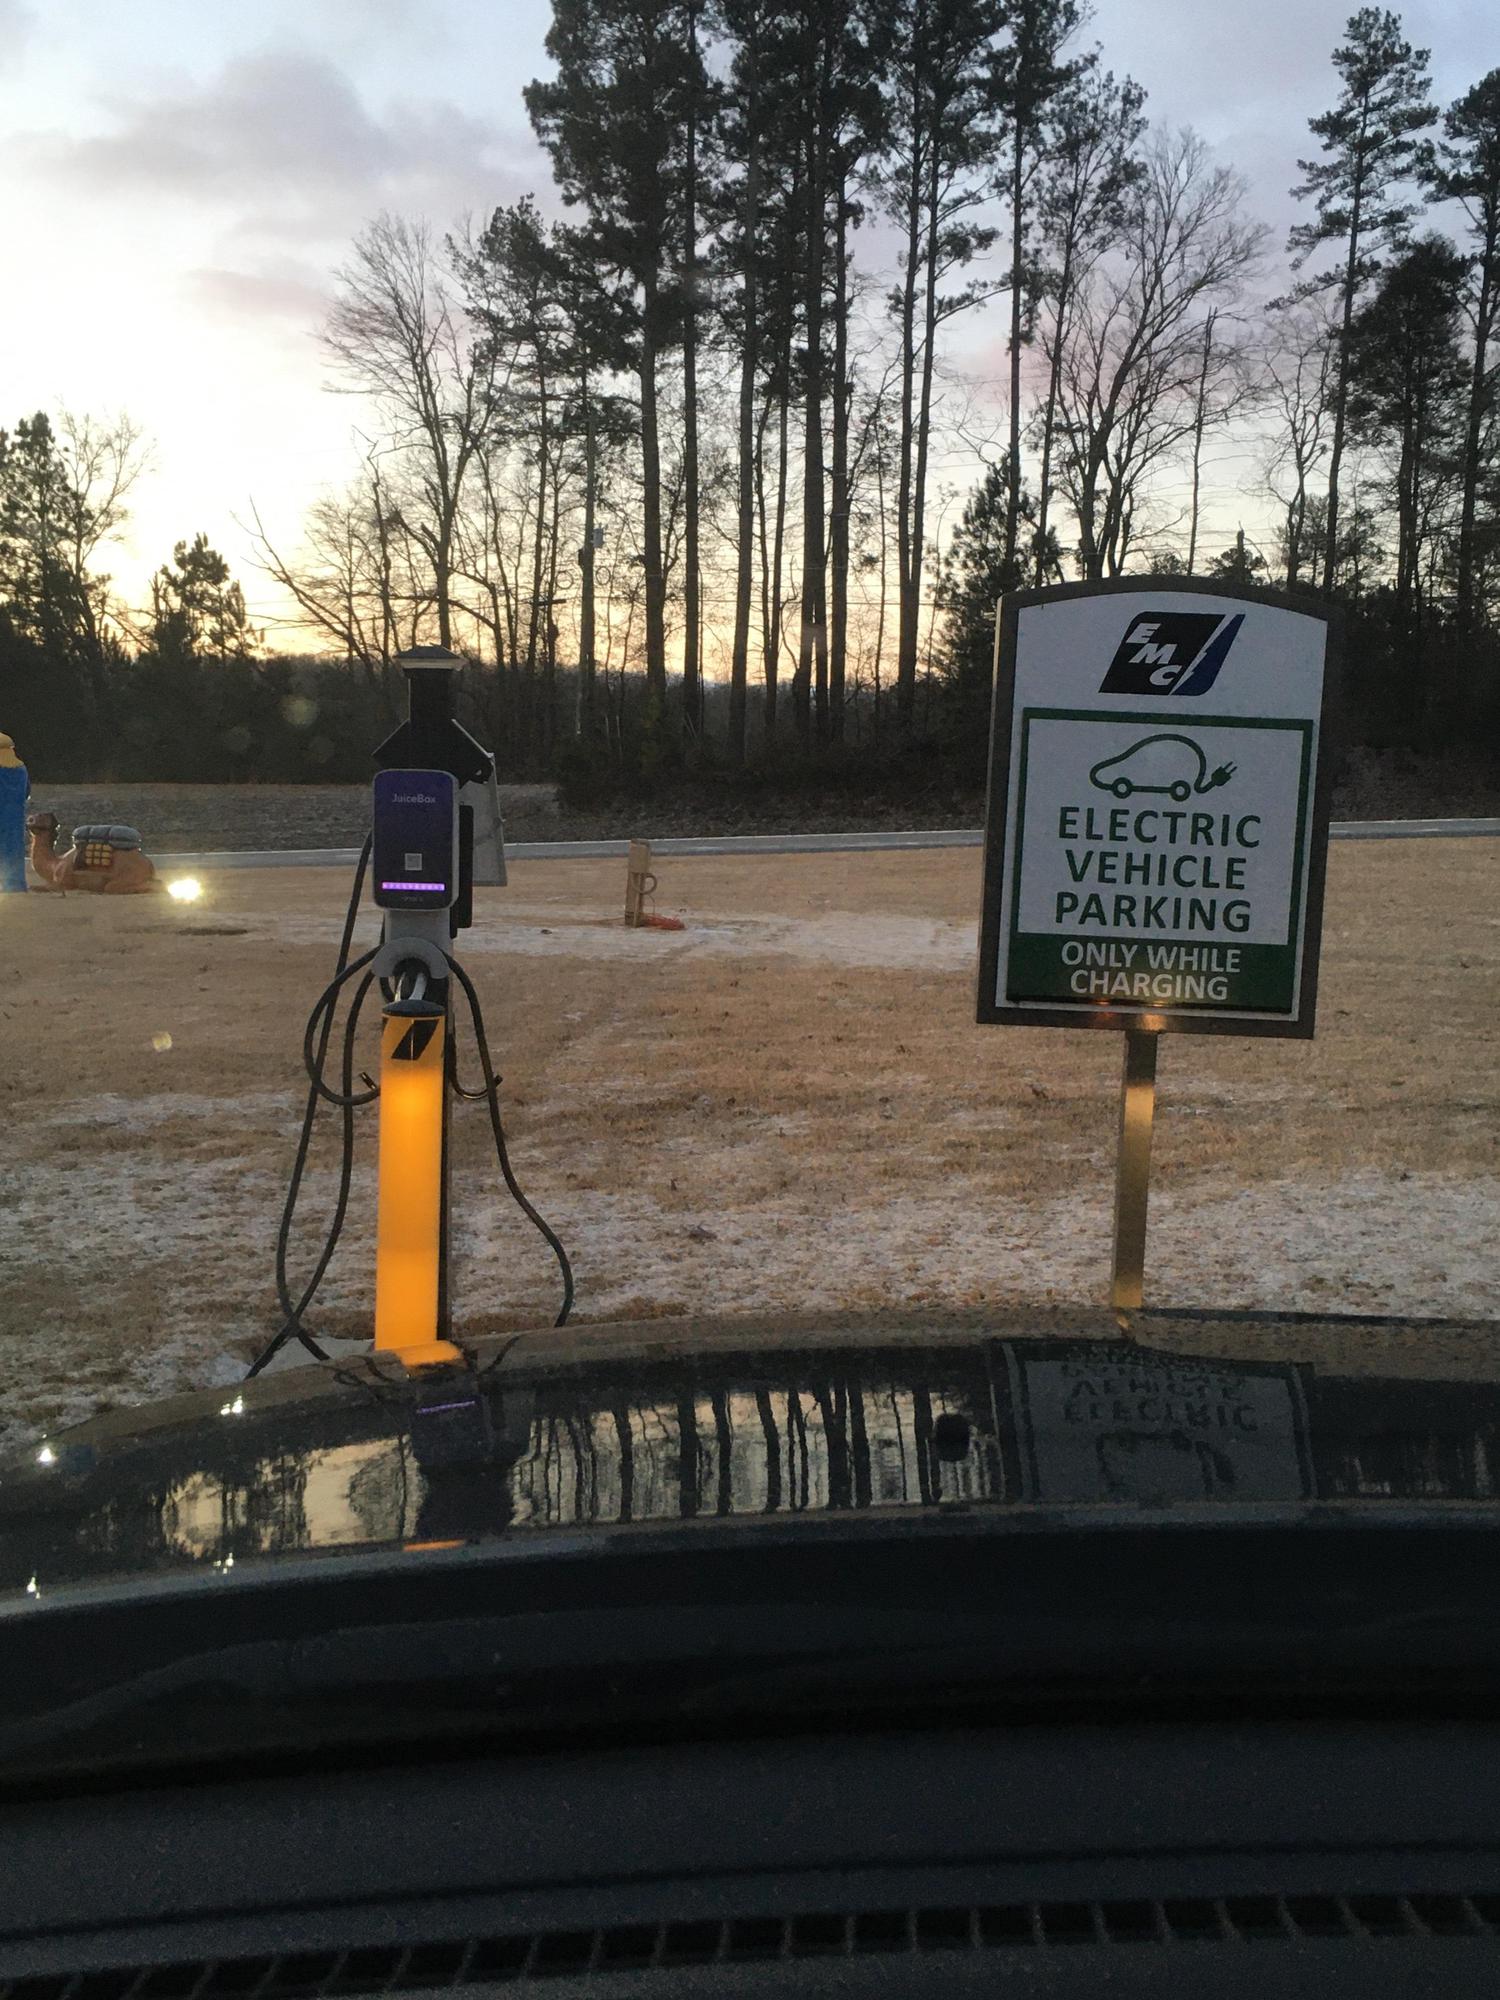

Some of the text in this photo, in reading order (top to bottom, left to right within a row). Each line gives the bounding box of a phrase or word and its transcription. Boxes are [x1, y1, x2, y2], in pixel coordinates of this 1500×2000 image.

[1126, 622, 1182, 686] EMC
[391, 792, 436, 804] JuiceBox
[1058, 806, 1261, 848] ELECTRIC
[1065, 850, 1247, 890] VEHICLE
[1055, 891, 1251, 932] PARKING
[1061, 941, 1241, 973] ONLY WHILE
[1070, 969, 1229, 1000] CHARGING
